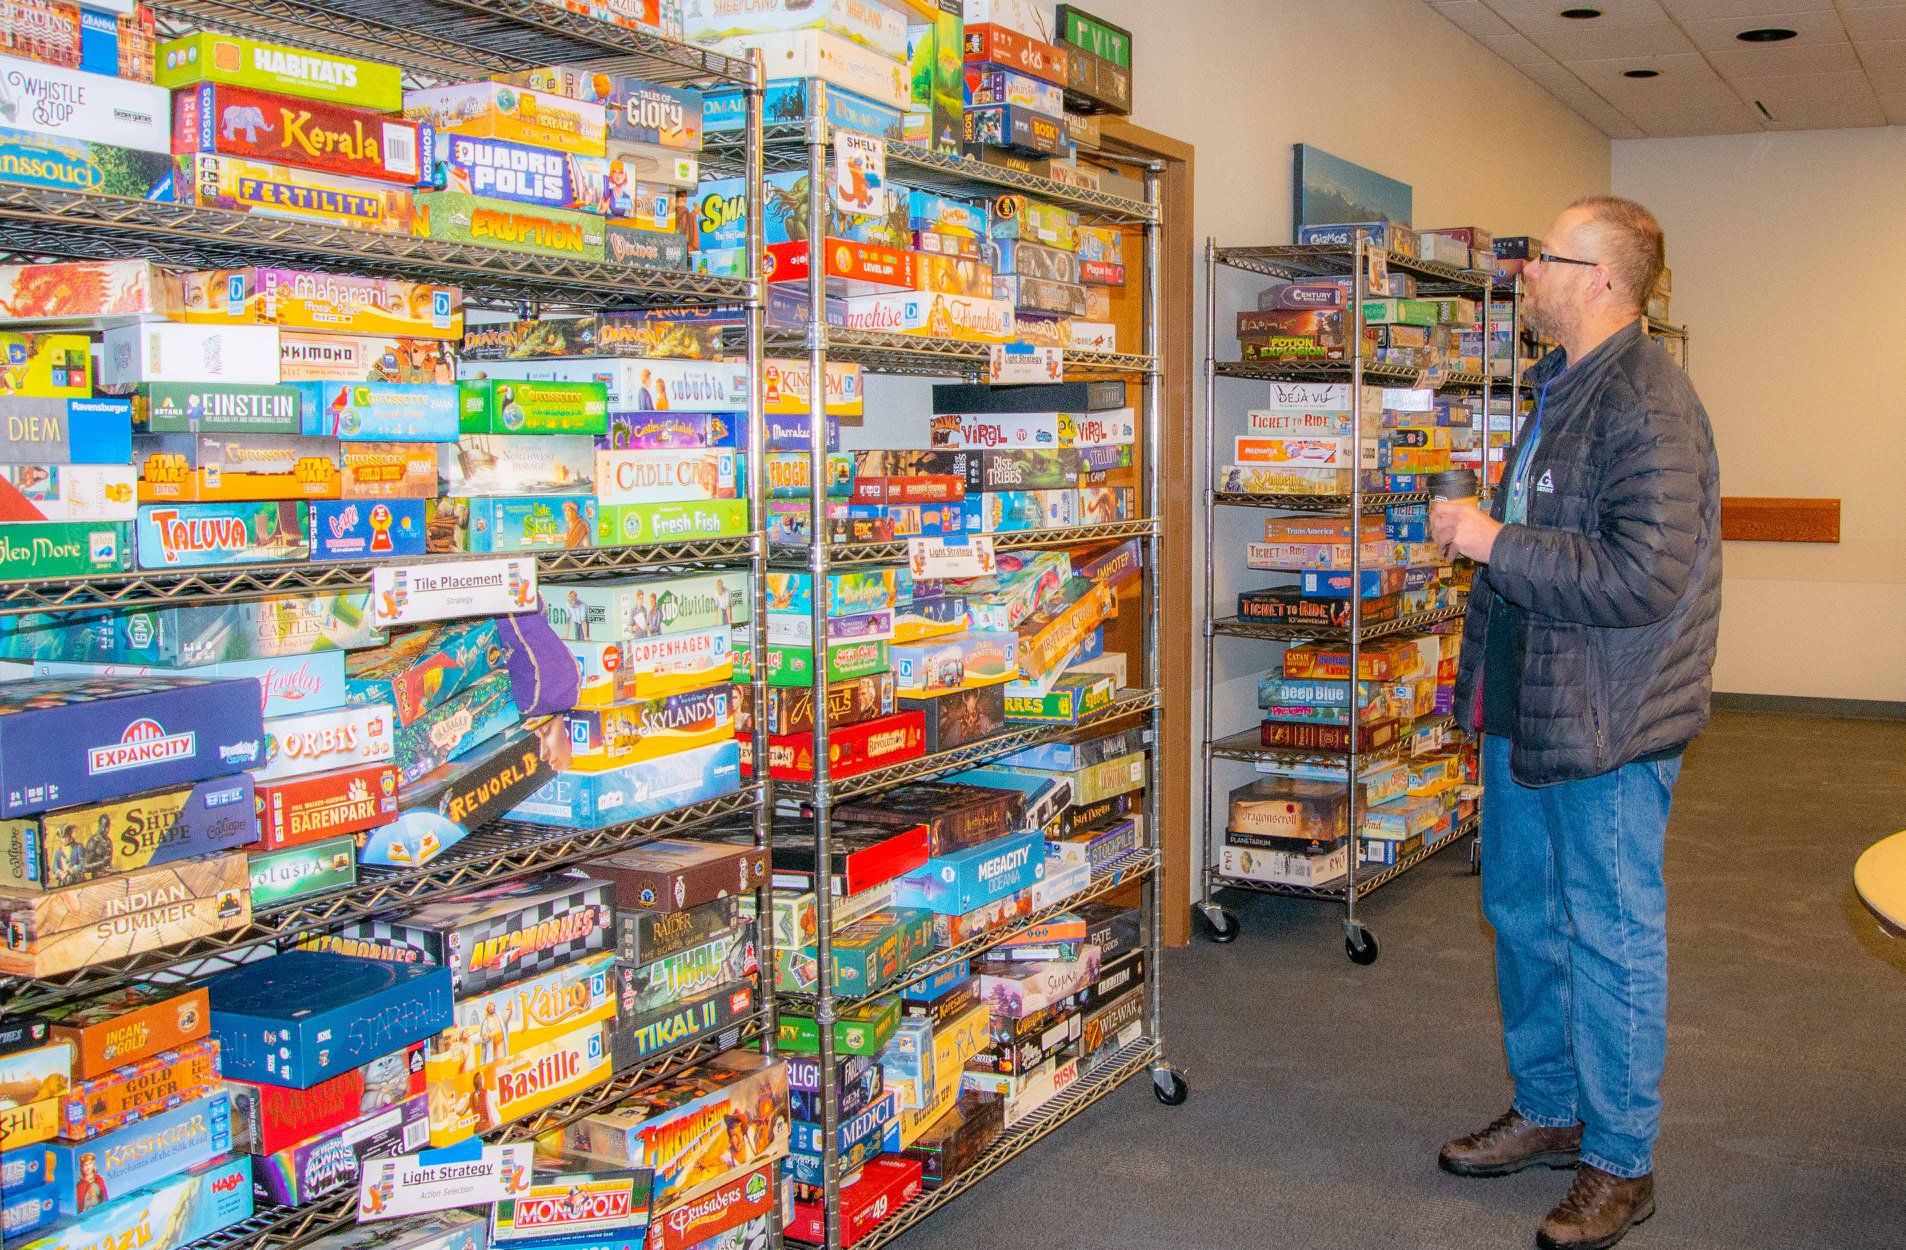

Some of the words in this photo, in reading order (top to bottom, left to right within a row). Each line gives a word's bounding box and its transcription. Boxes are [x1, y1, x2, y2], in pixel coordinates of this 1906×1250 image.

[82, 14, 117, 32] GRANNA
[254, 47, 358, 88] HABITATS
[8, 70, 86, 106] WHISTLE
[639, 90, 660, 102] TALES
[33, 99, 74, 127] STOP
[202, 87, 214, 148] KOSMOS
[279, 108, 382, 164] Kerala
[964, 113, 973, 141] BOSK
[1034, 120, 1057, 140] BOSK
[422, 126, 433, 183] KOSMOS
[456, 141, 564, 173] QUADRO
[846, 136, 878, 154] SHELF
[240, 180, 380, 219] FERTILITY
[470, 207, 584, 252] ERUPTION
[293, 274, 387, 306] Maharani
[1292, 289, 1331, 300] CENTURY
[464, 330, 518, 350] DRAKON
[600, 325, 656, 346] DRAKON
[1271, 337, 1314, 348] POTION
[1019, 354, 1043, 365] Strategy
[1260, 345, 1326, 358] EXPLOSION
[671, 373, 724, 402] suburbia
[71, 401, 129, 414] Ravensburger
[153, 407, 184, 417] ARTANA
[202, 394, 294, 418] EINSTEIN
[8, 416, 62, 443] DIEM
[1250, 414, 1291, 429] TICKET
[1304, 413, 1331, 428] RIDE
[150, 453, 186, 468] STAR
[148, 467, 187, 483] WARS
[616, 461, 671, 490] CABLE
[986, 468, 1022, 486] TRIBES
[151, 508, 248, 563] TALUVA
[652, 511, 691, 539] Fresh
[694, 509, 721, 534] Fish
[1286, 527, 1334, 536] TransAmerica
[32, 537, 81, 566] More
[929, 547, 945, 558] Light
[946, 548, 974, 560] Strategy
[1250, 545, 1281, 559] TICKET
[413, 576, 437, 591] Tile
[441, 572, 503, 589] Placement
[445, 596, 474, 607] Strategy
[1242, 599, 1286, 618] TICKET
[1286, 605, 1298, 615] TO
[1299, 600, 1329, 618] RIDE
[258, 620, 321, 639] CASTLES
[1286, 653, 1309, 662] CATAN
[1281, 686, 1314, 701] Deep
[1315, 685, 1344, 701] Blue
[638, 693, 716, 738] SKYLANDS
[95, 737, 191, 770] EXPANCITY
[868, 730, 906, 751] REVOLUTION!
[449, 750, 539, 823] REWORLD
[125, 804, 185, 836] SHIP
[290, 799, 376, 835] BÄRENPARK
[120, 824, 191, 857] SHAPE
[1092, 829, 1134, 864] STOCKPILE
[1230, 836, 1271, 847] PLANETARIUM
[977, 845, 1030, 883] MEGACITY
[105, 884, 187, 916] INDIAN
[97, 902, 196, 940] SUMMER
[653, 913, 693, 942] RAIDER
[468, 908, 594, 972] AUTOMOBILES
[1090, 927, 1112, 945] FATE
[519, 981, 587, 1034] Kairo
[106, 1022, 142, 1045] INCAN
[348, 988, 447, 1055] STARFALL
[634, 1007, 699, 1056] TIKAL
[702, 1000, 718, 1028] II
[117, 1034, 147, 1057] GOLD
[125, 1068, 173, 1094] GOLD
[497, 1049, 580, 1107] Bastille
[1053, 1061, 1077, 1090] RISK
[121, 1081, 179, 1114] FEVER
[942, 1084, 953, 1106] UP!
[842, 1098, 890, 1149] MEDICI
[103, 1114, 208, 1172] KASHGAR
[107, 1158, 150, 1183] Merchants
[305, 1144, 355, 1172] ALWAYS
[211, 1171, 245, 1195] HABA
[304, 1157, 358, 1188] WINS
[402, 1168, 437, 1186] Light
[439, 1162, 494, 1181] Strategy
[419, 1188, 441, 1200] Action
[443, 1184, 474, 1197] Selection
[517, 1193, 629, 1224] MONOPOLY
[872, 1193, 888, 1220] 49
